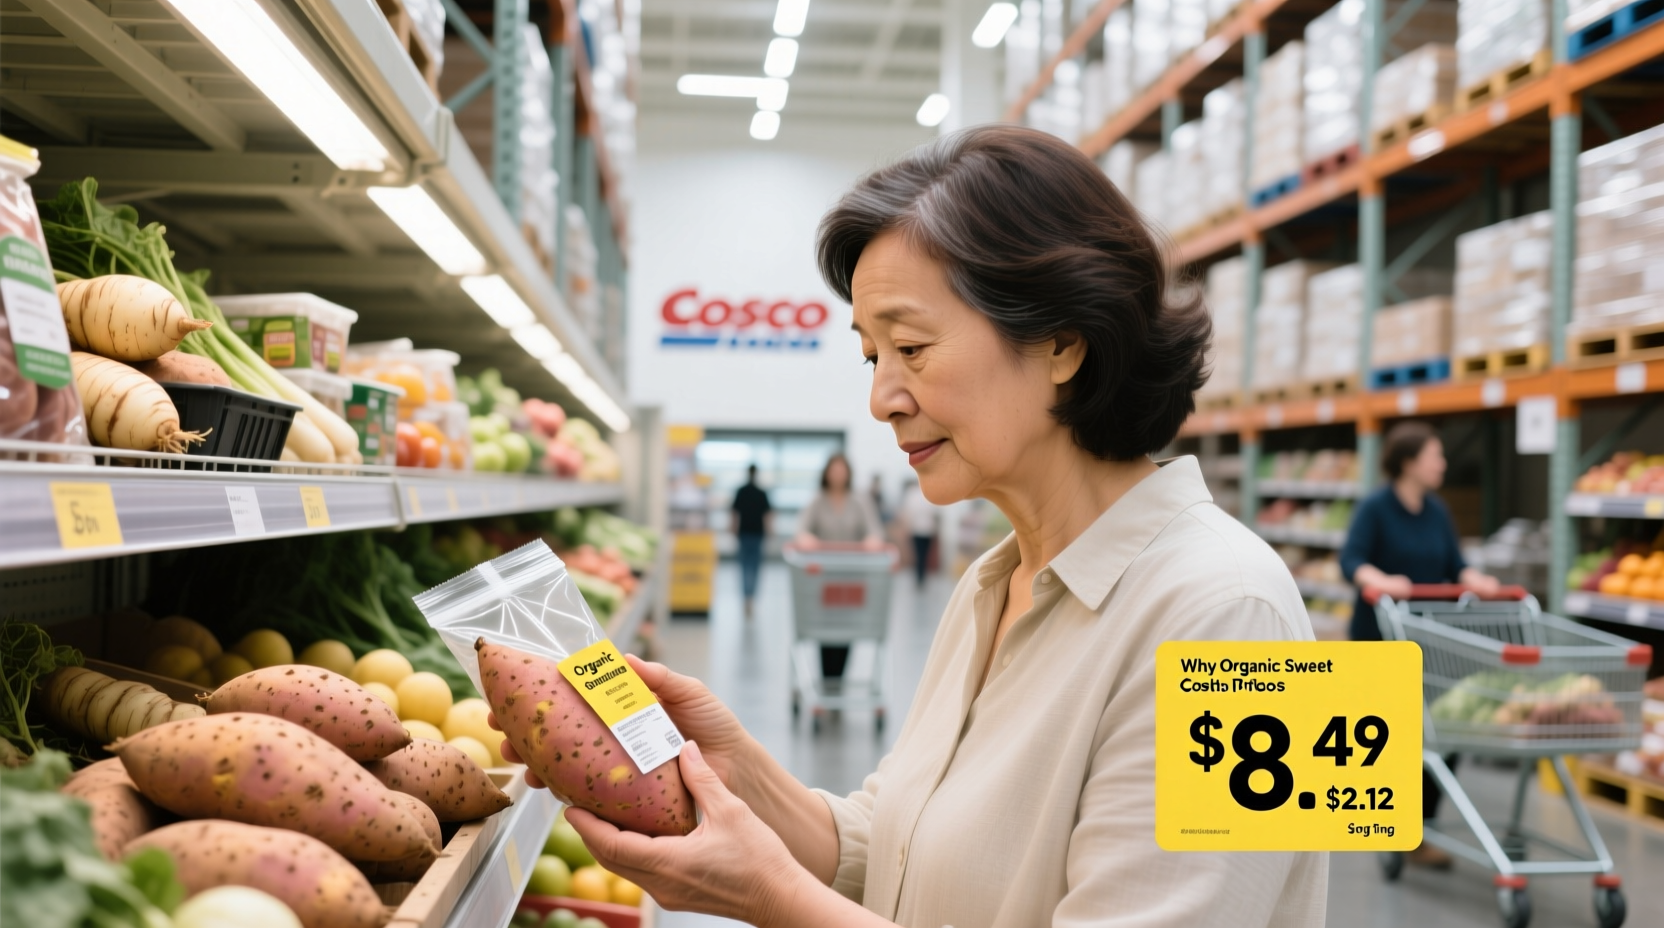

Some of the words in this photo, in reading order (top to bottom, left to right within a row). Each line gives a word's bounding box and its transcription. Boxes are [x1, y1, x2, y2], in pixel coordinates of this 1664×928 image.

[660, 288, 829, 330] Cosco
[1180, 658, 1217, 676] Why
[1219, 657, 1281, 677] Organic
[1284, 658, 1333, 673] Sweet
[1325, 784, 1395, 813] $2.12
